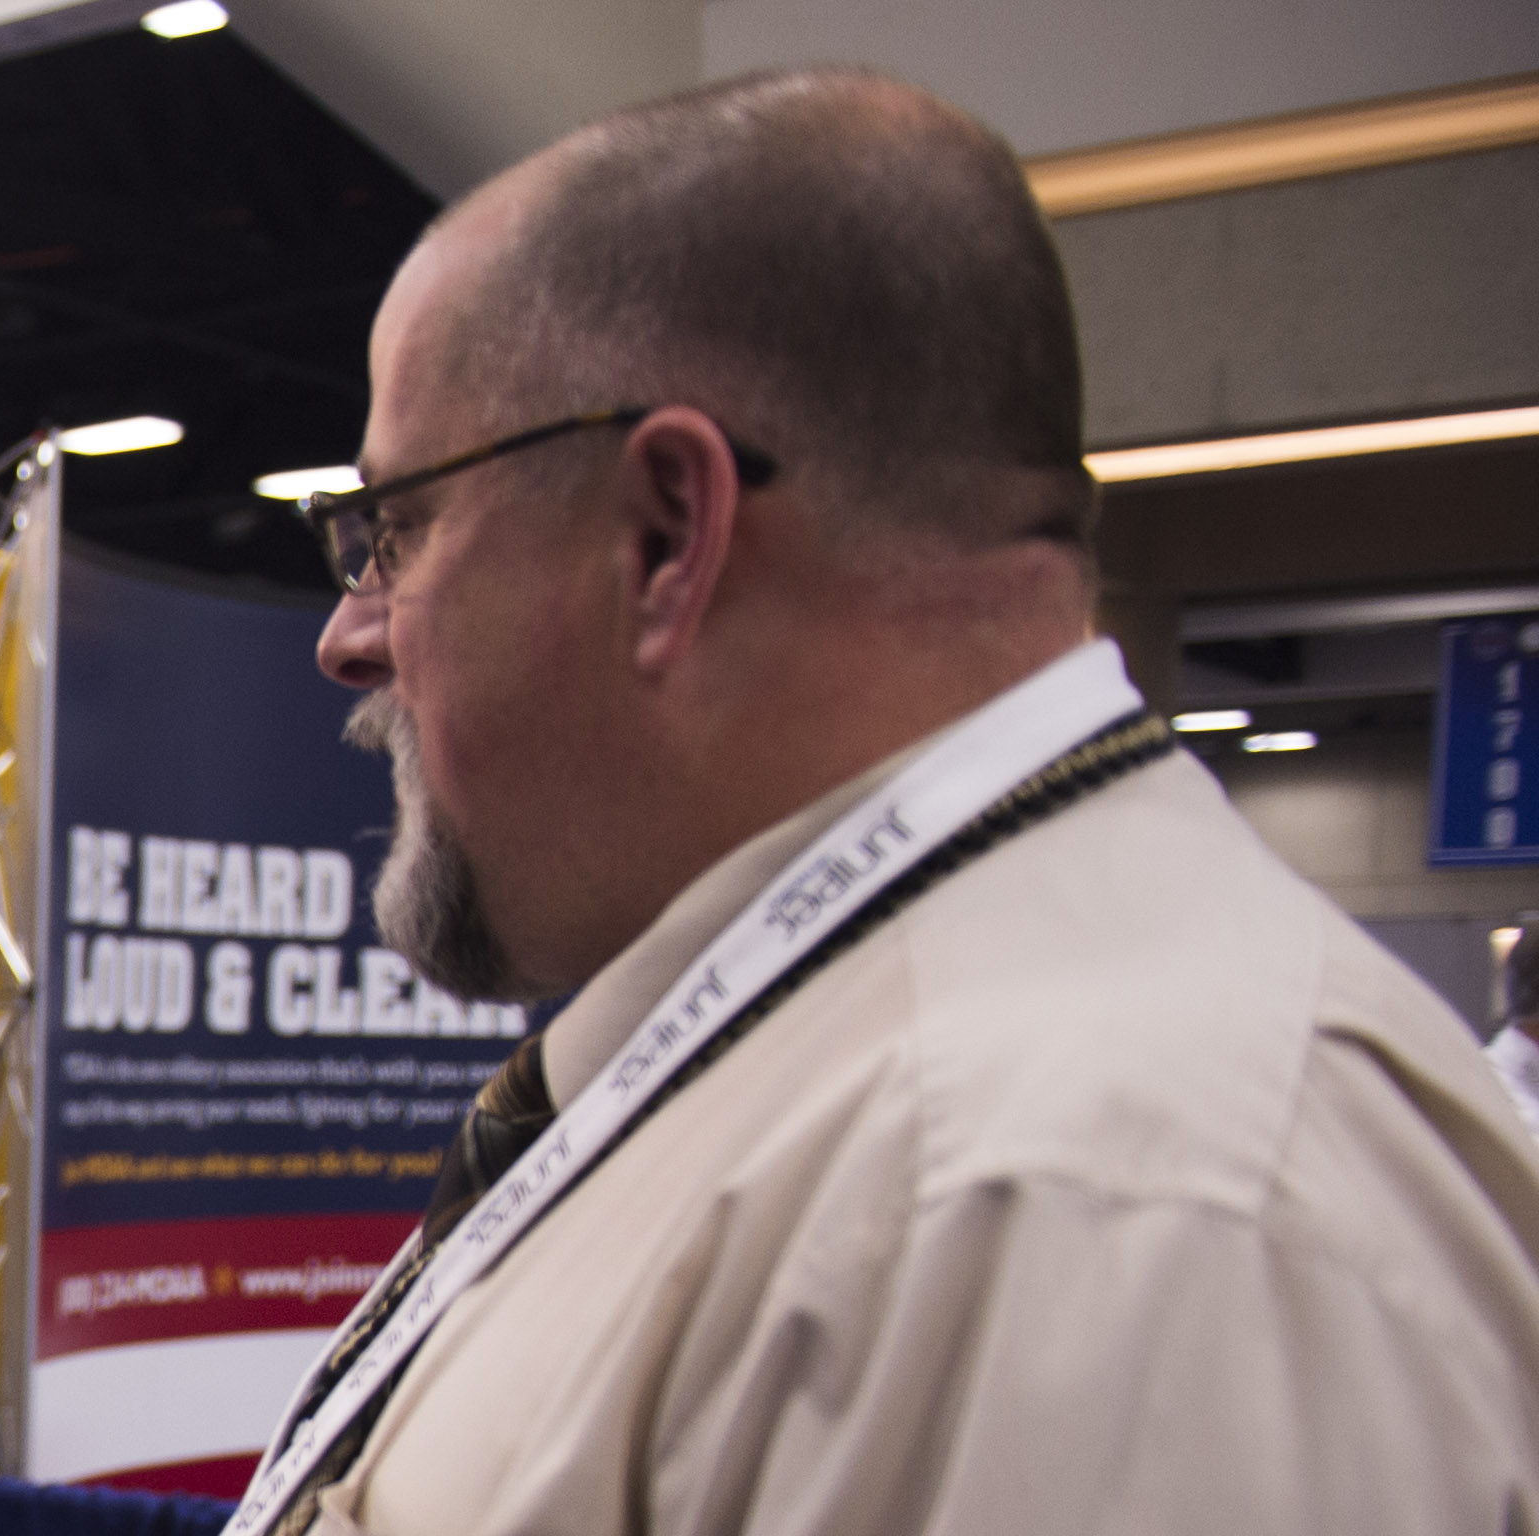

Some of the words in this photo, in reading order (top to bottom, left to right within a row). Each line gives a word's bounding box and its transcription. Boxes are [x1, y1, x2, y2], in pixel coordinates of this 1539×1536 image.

[68, 825, 131, 928] BE
[139, 835, 354, 940] HEARD
[63, 931, 194, 1033] LOUD
[205, 939, 254, 1036] &
